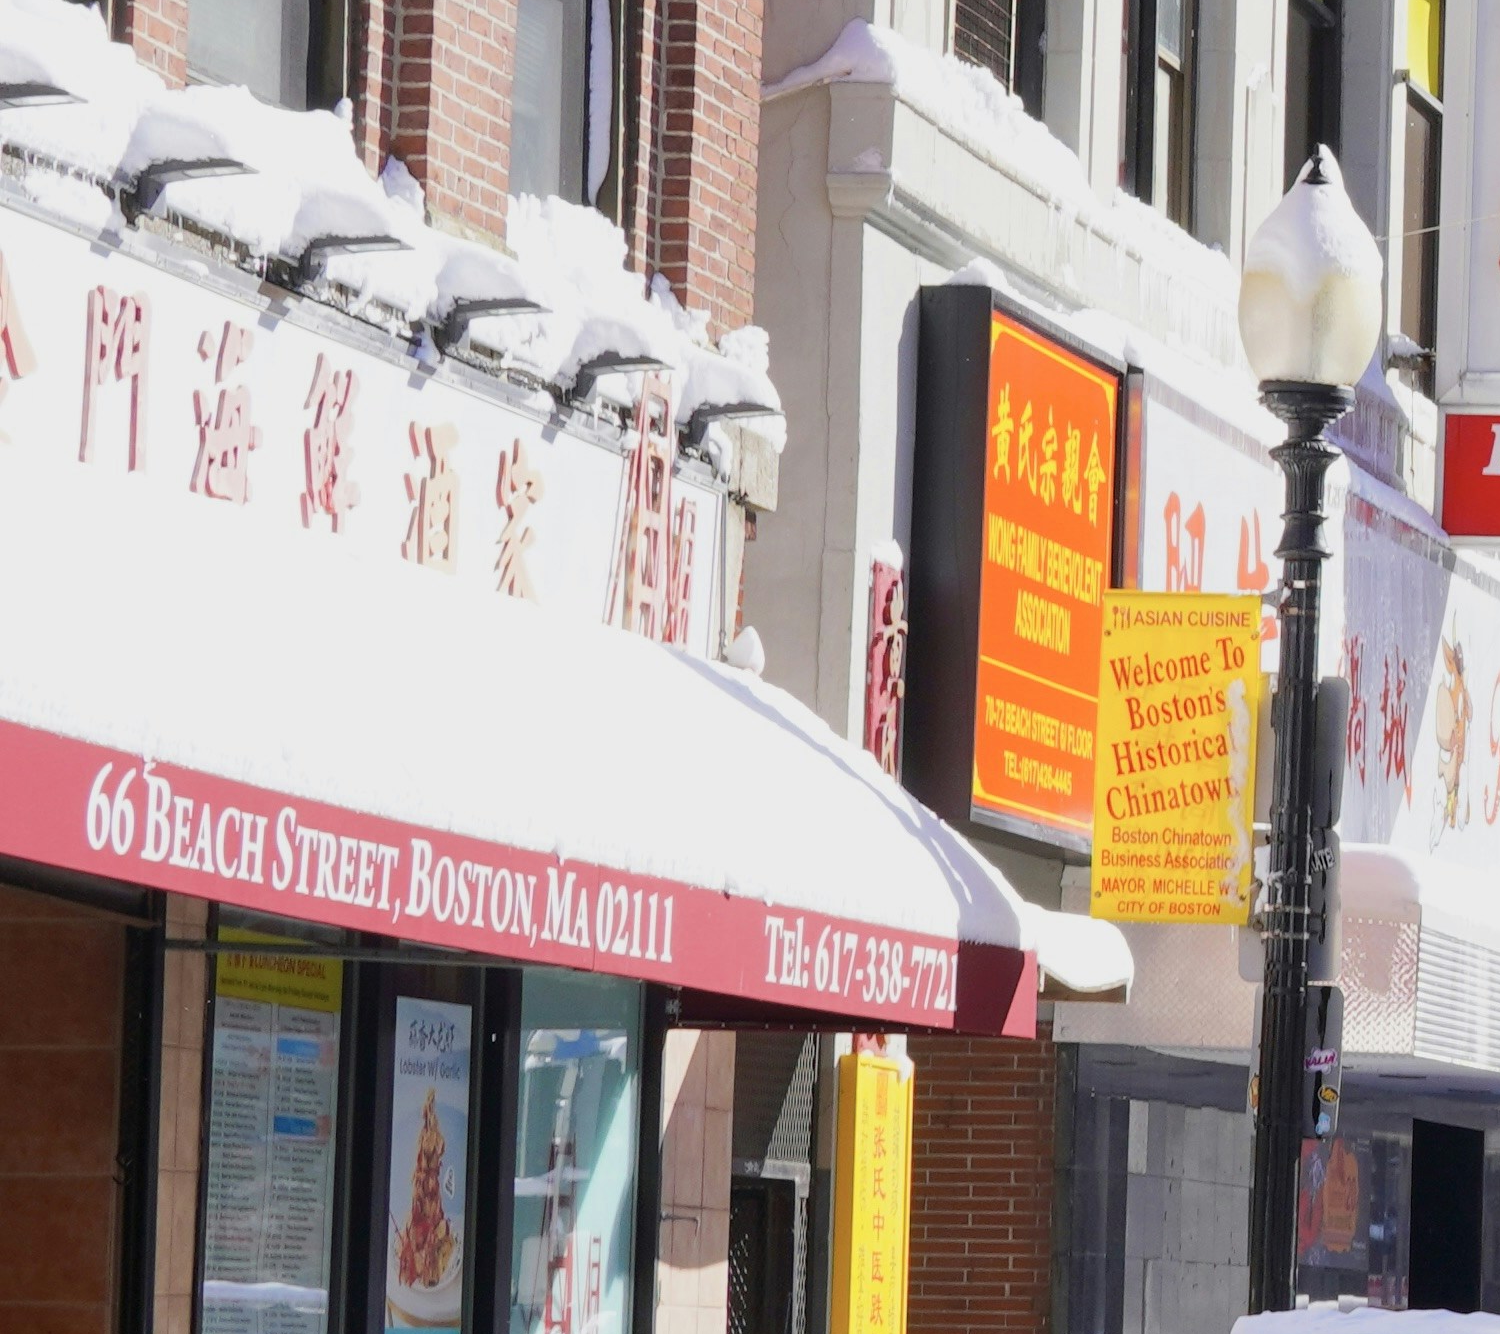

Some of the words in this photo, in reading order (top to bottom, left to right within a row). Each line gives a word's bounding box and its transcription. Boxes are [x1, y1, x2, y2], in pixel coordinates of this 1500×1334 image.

[988, 512, 1016, 571] WONG
[1016, 526, 1047, 584] FAMILY
[1047, 539, 1103, 608] BENEVOLENT
[1015, 588, 1071, 655] ASSOCIATION
[1133, 610, 1183, 627] ASIAN
[1188, 611, 1250, 628] CUISINE
[1110, 651, 1211, 691] Welcome
[1215, 637, 1244, 672] To
[1005, 702, 1031, 740] BEACH
[1032, 711, 1059, 749] STREET
[1067, 724, 1093, 760] FLOOR
[1125, 687, 1226, 731] Boston's
[1111, 728, 1232, 776] Historica
[1101, 849, 1160, 868] Business
[1164, 852, 1236, 870] Associati
[1112, 826, 1157, 844] Boston
[1162, 827, 1232, 846] Chinatown
[86, 763, 136, 857] 66
[596, 880, 674, 964] 02111
[1101, 878, 1145, 893] MAYOR
[1152, 878, 1215, 896] MICHELLE
[1117, 900, 1144, 915] CITY
[1149, 901, 1164, 914] OF
[1169, 902, 1221, 916] BOSTON
[814, 925, 958, 1013] 617-338-7721
